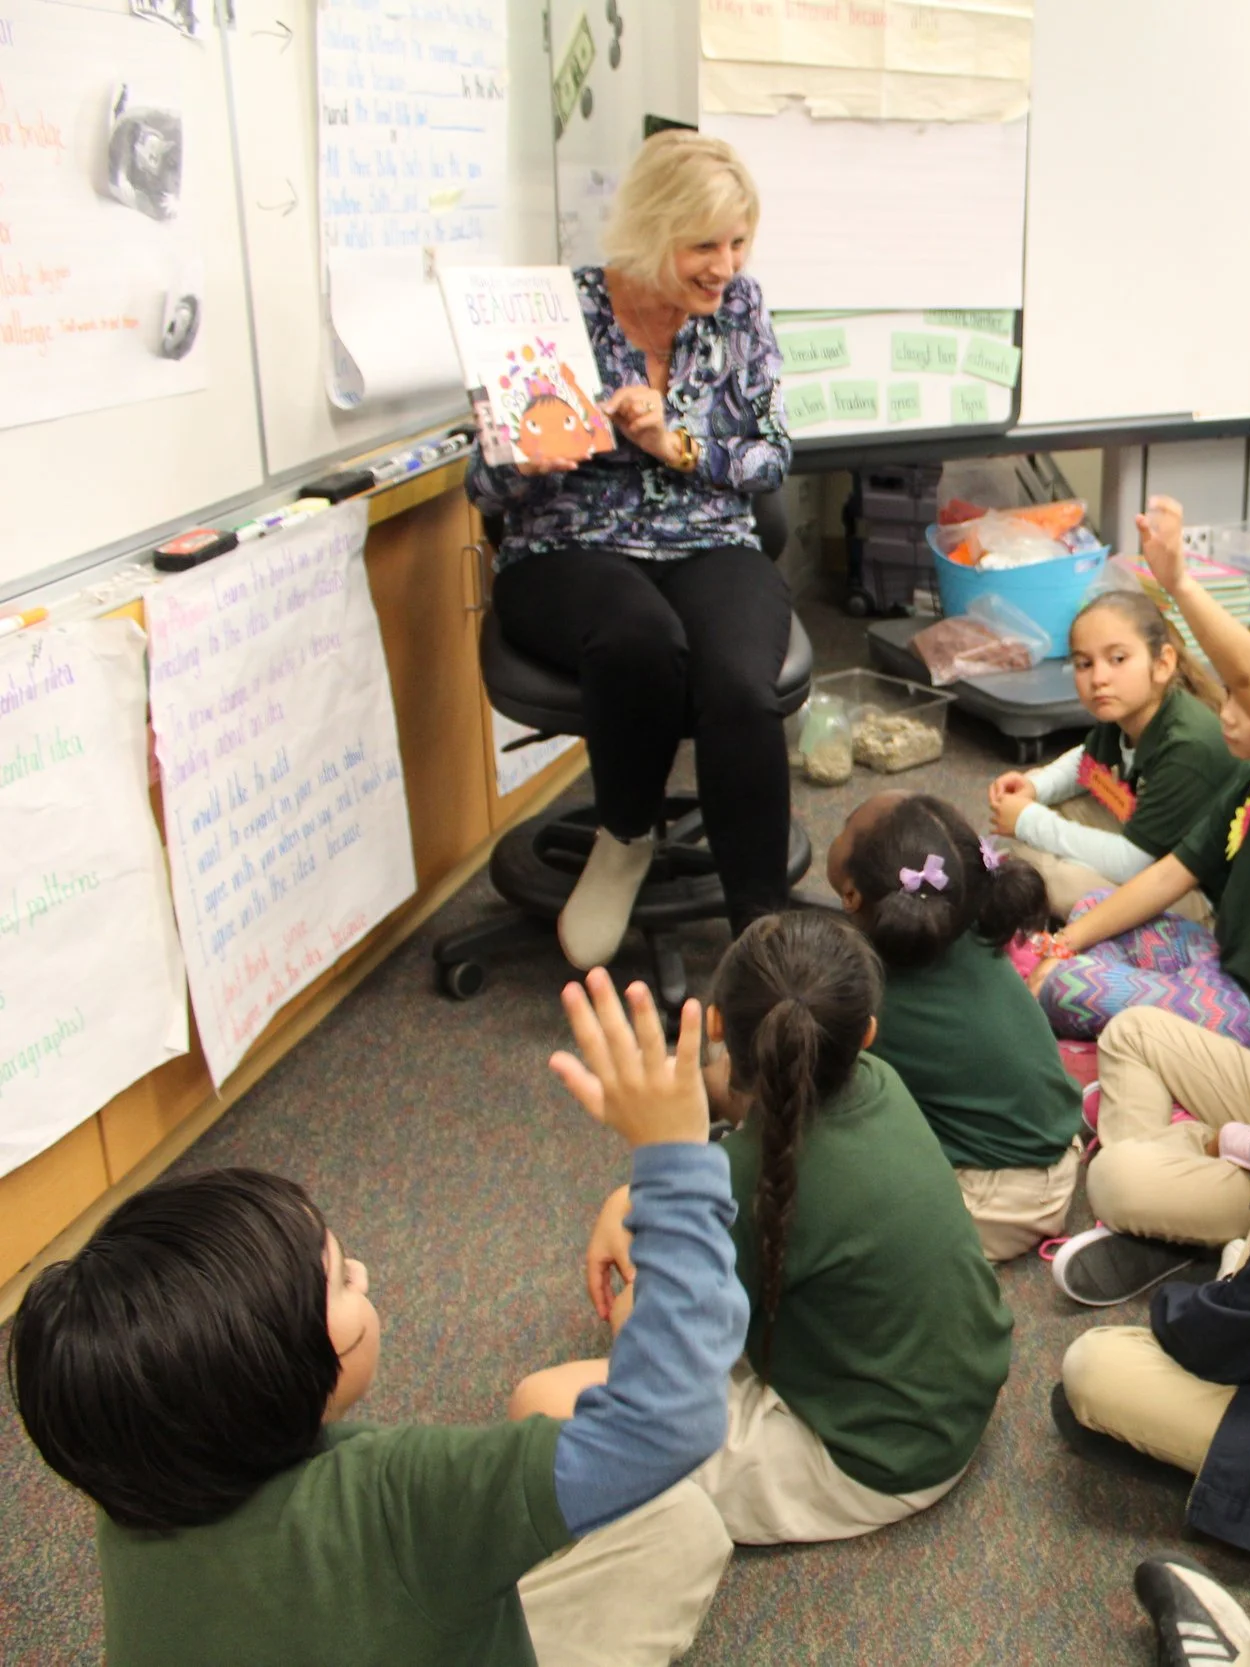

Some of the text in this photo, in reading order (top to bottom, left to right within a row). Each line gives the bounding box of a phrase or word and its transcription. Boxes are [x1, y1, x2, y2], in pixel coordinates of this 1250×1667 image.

[464, 292, 570, 326] BEAUTIFUL
[0, 733, 45, 788] entral
[192, 784, 222, 835] would
[270, 744, 290, 783] add
[243, 794, 279, 838] expand
[269, 873, 288, 903] the
[293, 850, 316, 885] idea
[325, 822, 364, 861] because
[27, 871, 101, 930] patterns
[328, 911, 368, 950] because
